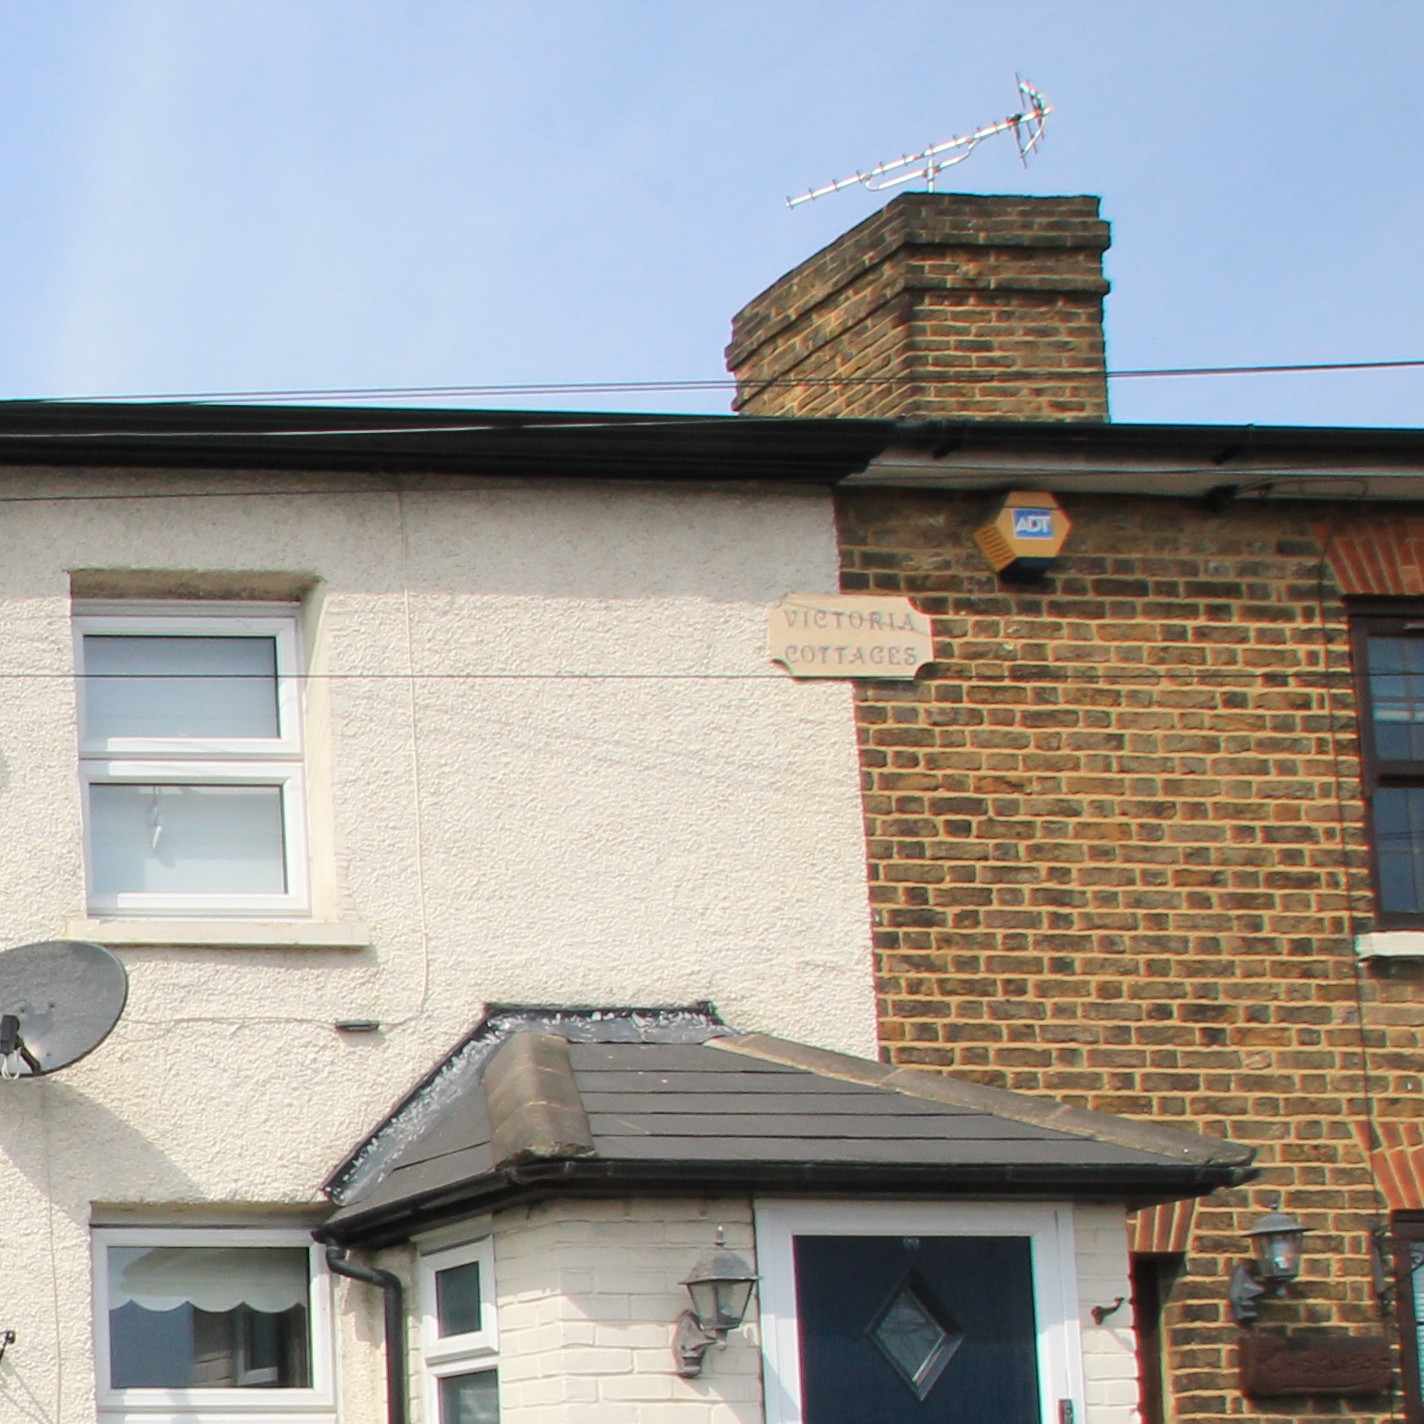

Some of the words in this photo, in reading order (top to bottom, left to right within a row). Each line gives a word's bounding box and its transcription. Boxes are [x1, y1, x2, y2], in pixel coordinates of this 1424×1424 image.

[1015, 515, 1051, 533] ADT
[783, 610, 916, 631] VICTORIA
[784, 645, 918, 666] COTTAGES
